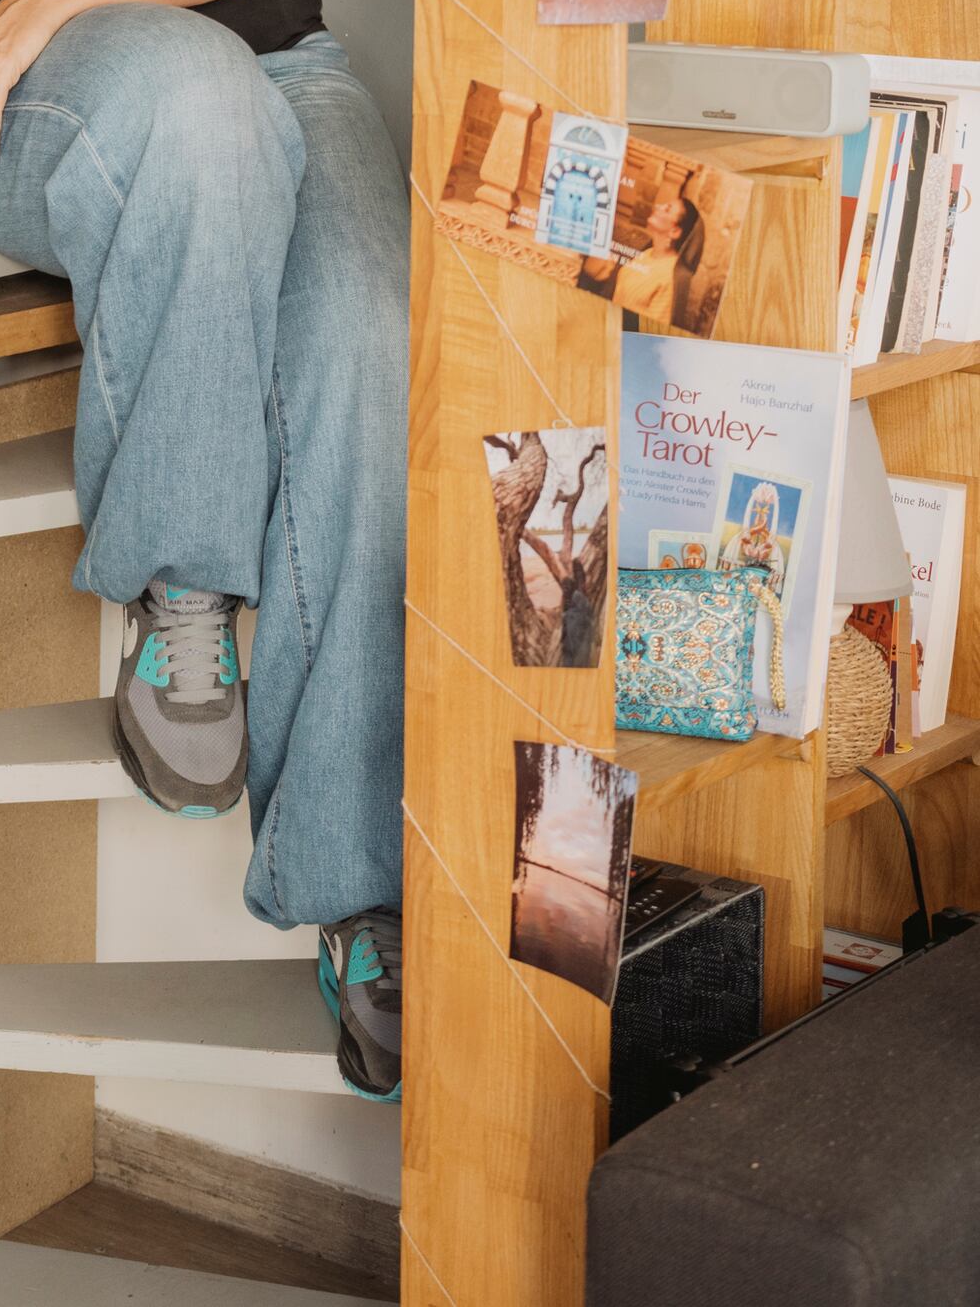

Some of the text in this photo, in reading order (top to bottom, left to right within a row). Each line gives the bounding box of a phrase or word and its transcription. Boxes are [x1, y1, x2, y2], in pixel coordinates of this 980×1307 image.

[663, 382, 702, 405] Der
[740, 379, 776, 393] Akron
[740, 394, 815, 413] Hajo Banzhaf
[635, 400, 778, 451] Crowley-
[637, 430, 714, 468] Tarot
[623, 464, 715, 486] Das Handbuch zu den
[627, 479, 642, 487] von
[676, 485, 712, 500] Crowley
[632, 490, 707, 509] Lady Frieda Harris
[918, 497, 942, 511] Bode
[911, 561, 933, 582] kel
